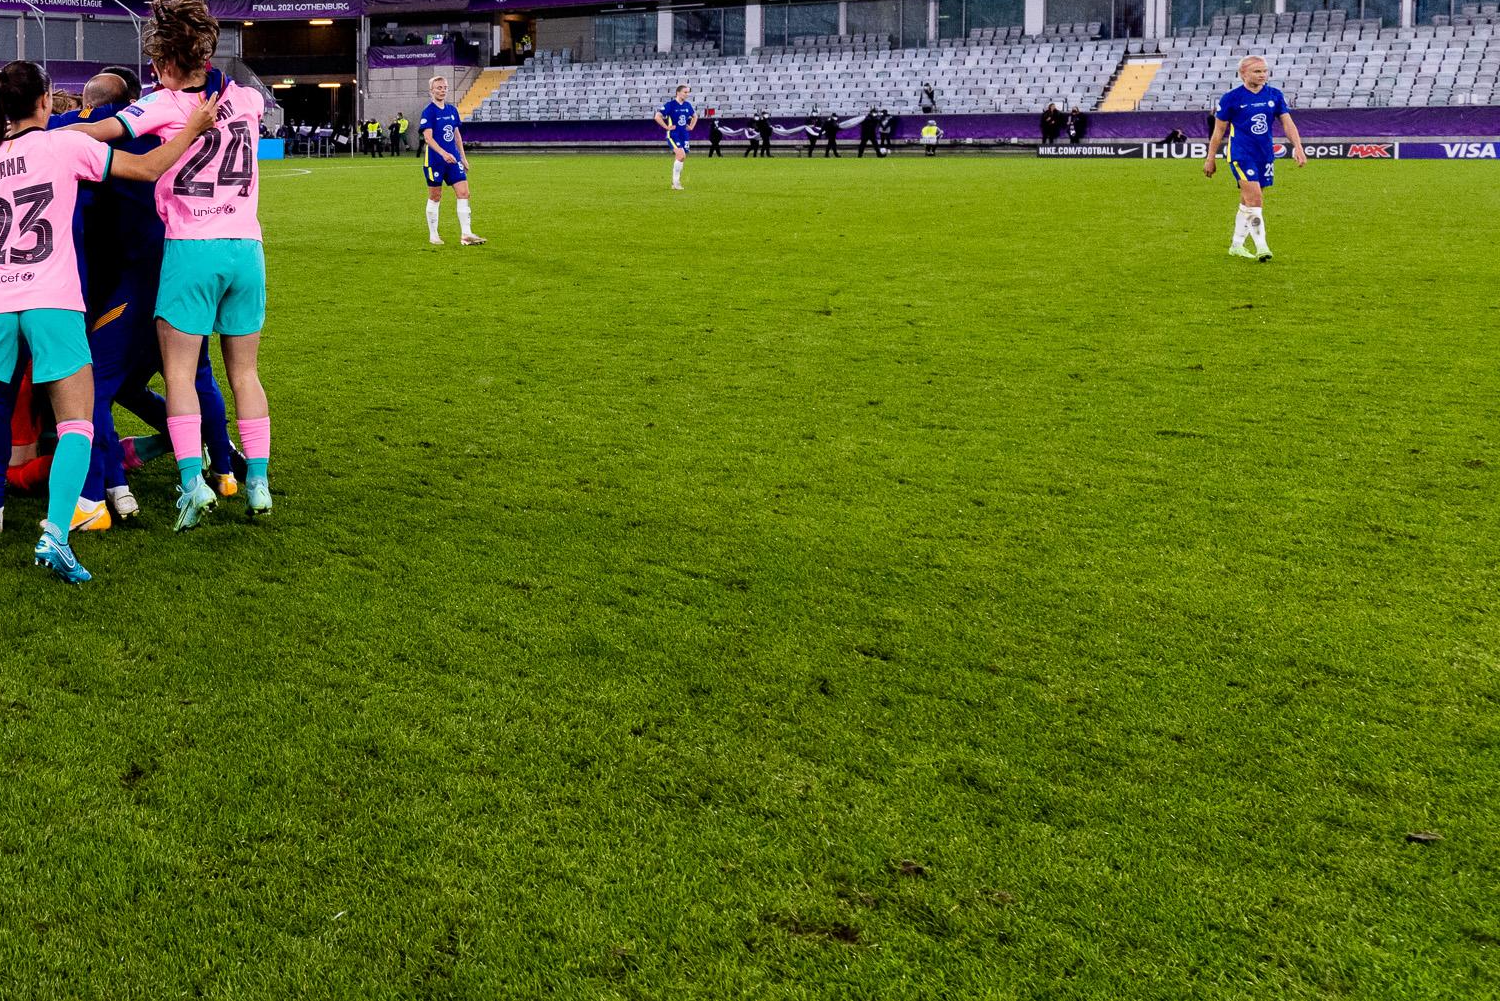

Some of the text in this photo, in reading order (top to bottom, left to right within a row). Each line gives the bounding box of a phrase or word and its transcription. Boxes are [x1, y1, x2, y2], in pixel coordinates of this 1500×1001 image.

[79, 0, 102, 8] LEAGUE
[253, 2, 350, 12] FINAL 2021 GOTHENBURG
[1251, 113, 1268, 134] 3
[443, 124, 454, 142] 3
[1038, 146, 1116, 156] NIKE.COM/FOOTBALL
[1347, 144, 1393, 158] MAX
[1439, 143, 1497, 158] VISA
[173, 120, 253, 198] 24
